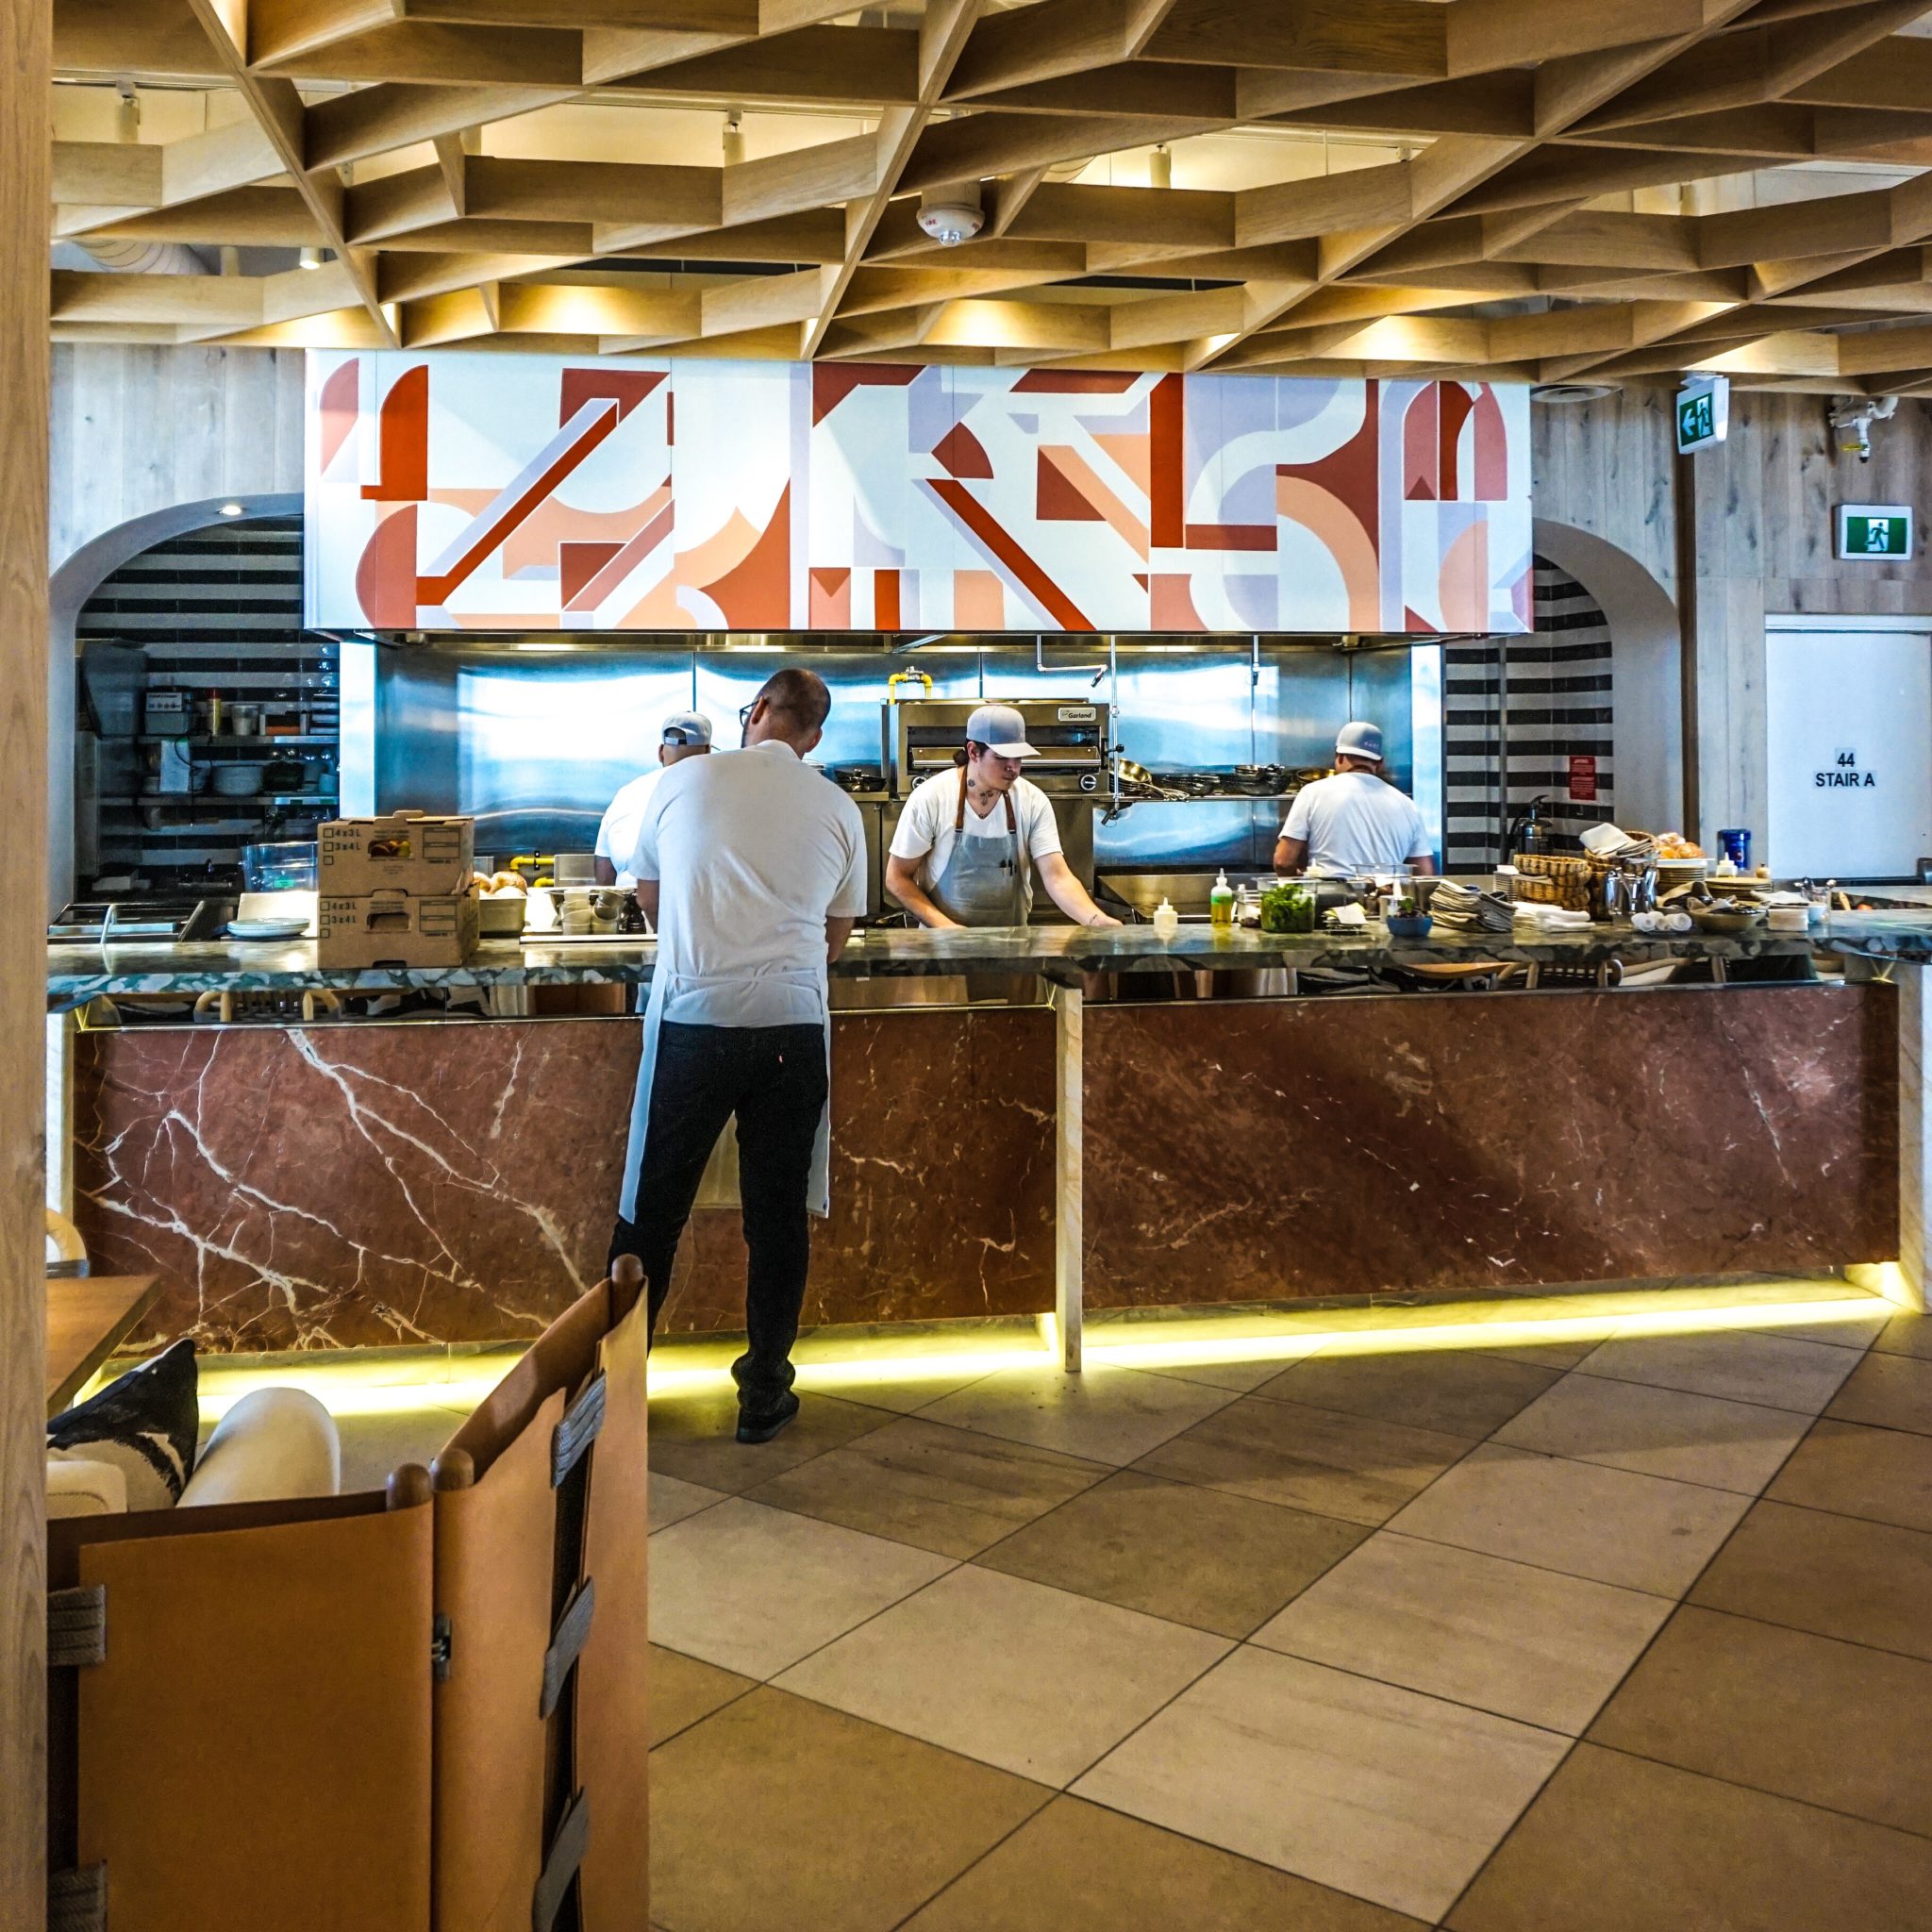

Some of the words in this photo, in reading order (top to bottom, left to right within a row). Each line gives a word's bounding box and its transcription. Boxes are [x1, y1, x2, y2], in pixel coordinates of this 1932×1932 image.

[1837, 752, 1856, 767] 44
[1815, 772, 1860, 787] STAIR
[1863, 772, 1875, 787] A
